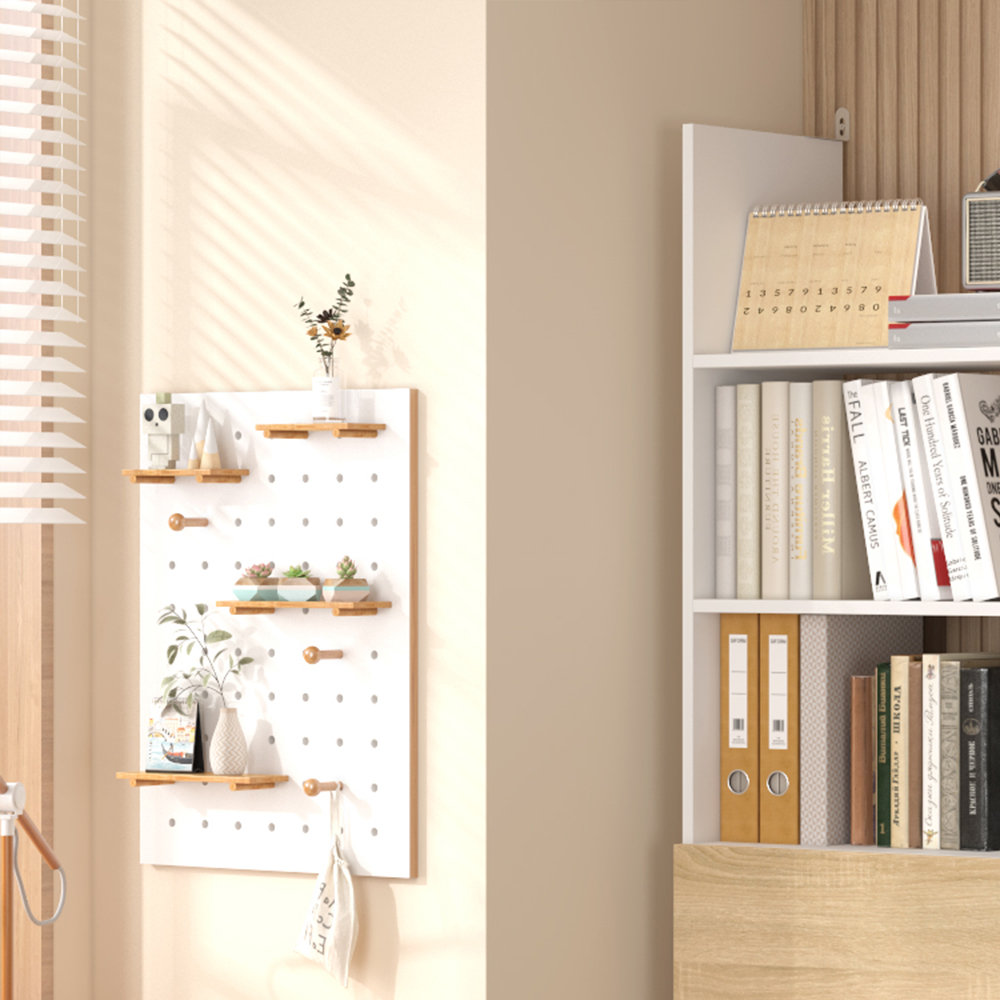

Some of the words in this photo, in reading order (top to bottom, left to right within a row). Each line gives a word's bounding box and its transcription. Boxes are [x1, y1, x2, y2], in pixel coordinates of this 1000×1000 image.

[849, 400, 865, 444] FALL
[920, 394, 931, 416] One
[924, 417, 943, 458] Hundred
[858, 460, 874, 505] ALBERT
[932, 457, 946, 486] Years
[865, 509, 880, 550] CAMUS
[939, 502, 956, 539] Solitude
[892, 686, 902, 734] ШКОЛА
